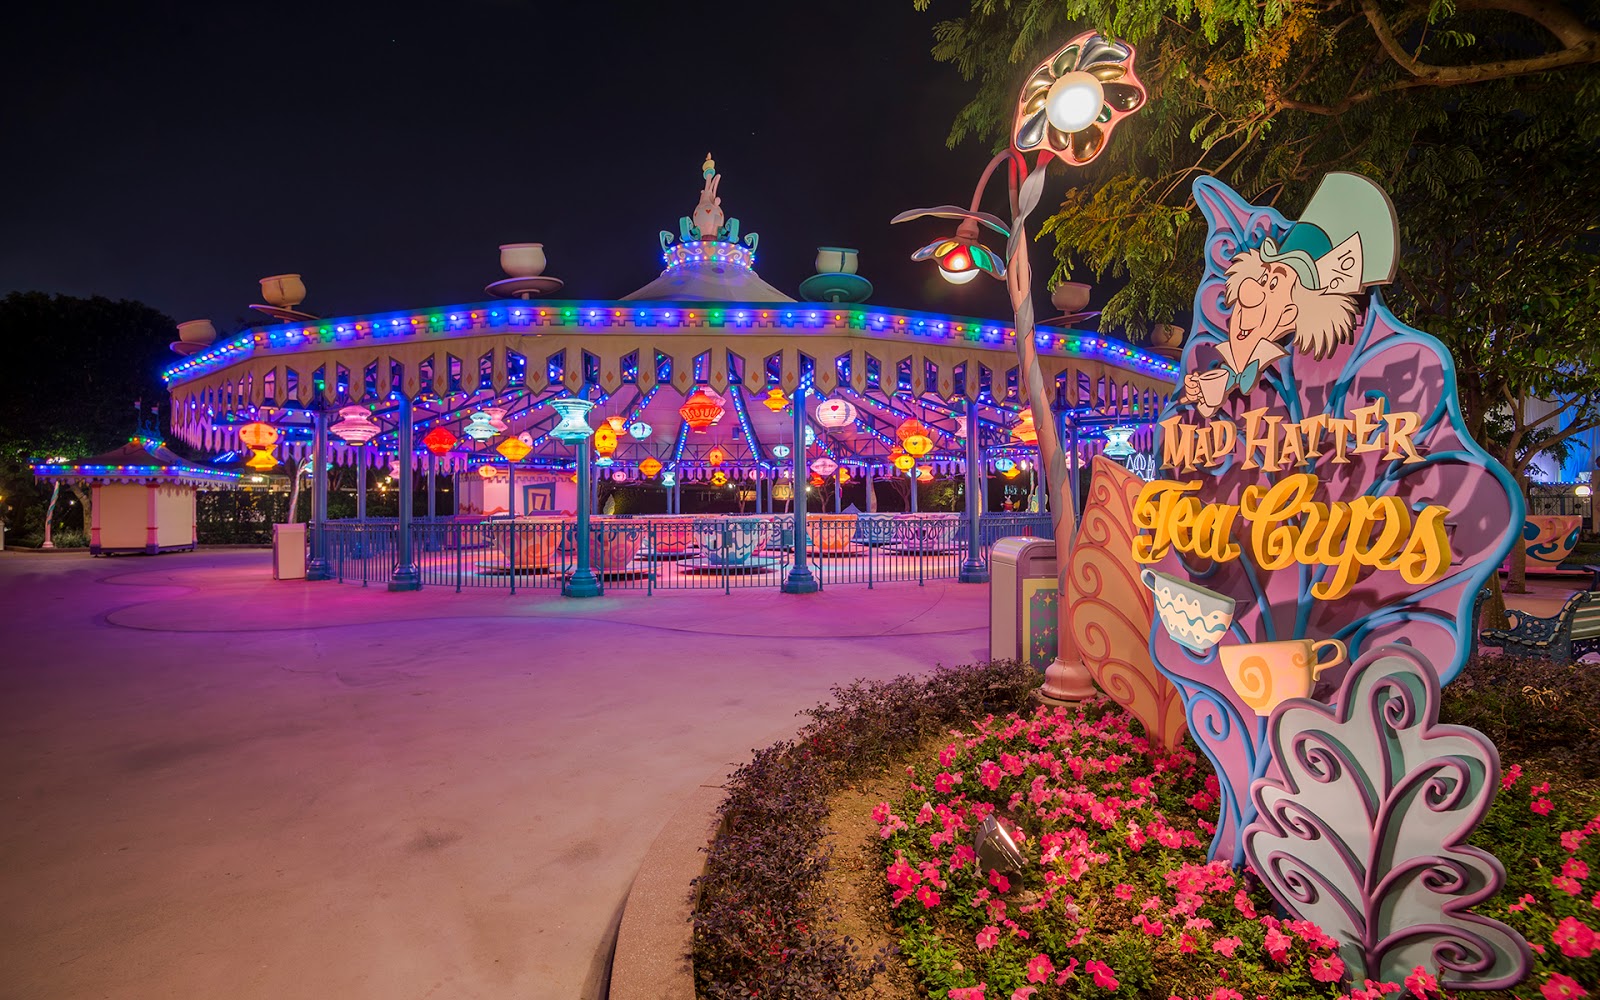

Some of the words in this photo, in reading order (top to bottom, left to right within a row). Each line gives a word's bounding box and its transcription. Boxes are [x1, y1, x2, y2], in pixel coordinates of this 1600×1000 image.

[1159, 415, 1237, 474] MAD
[1240, 397, 1427, 473] HATTER
[1132, 480, 1241, 562] Tea
[1242, 473, 1451, 599] Cups
